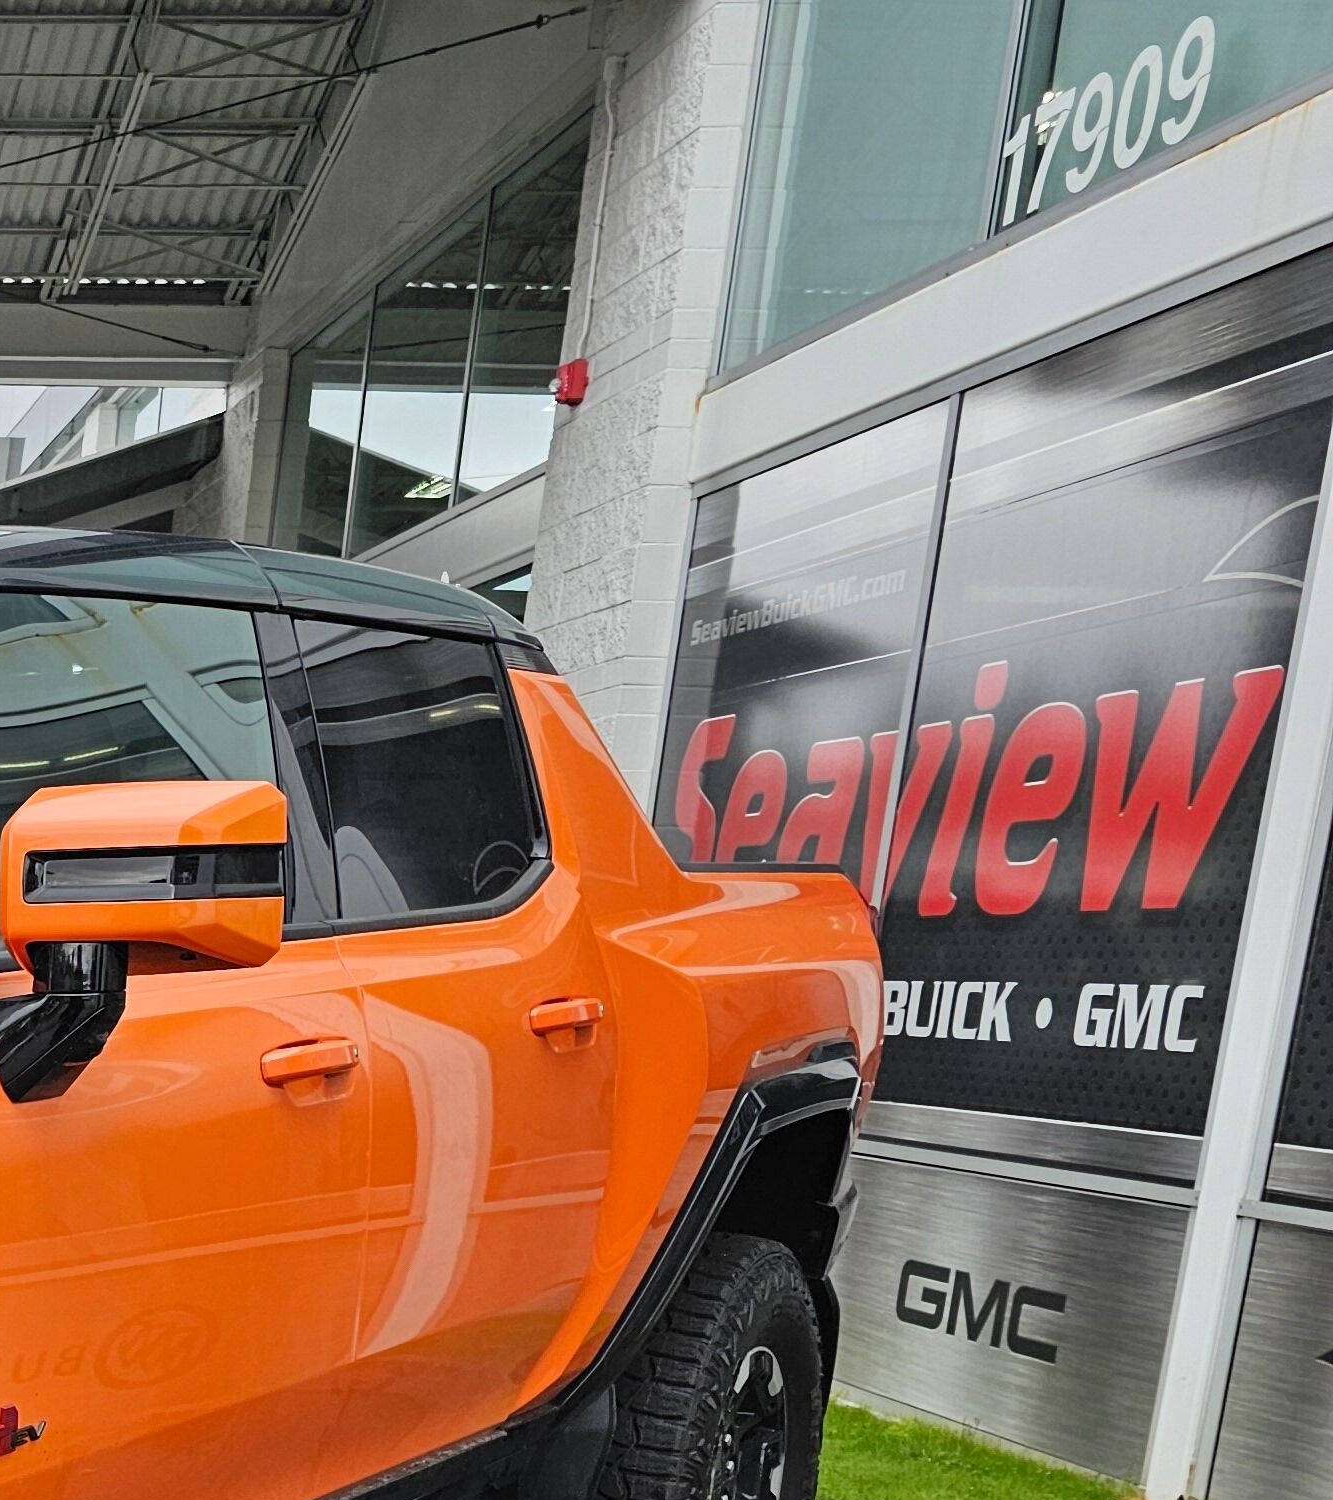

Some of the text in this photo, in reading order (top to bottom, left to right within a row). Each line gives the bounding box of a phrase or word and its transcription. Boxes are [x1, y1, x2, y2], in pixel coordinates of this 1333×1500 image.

[1003, 15, 1216, 227] 17909
[689, 569, 907, 646] SeaviewBuickGMC.com
[675, 660, 1285, 917] Seaview
[882, 980, 1205, 1053] BUICK GMC
[895, 1258, 1068, 1364] GMC
